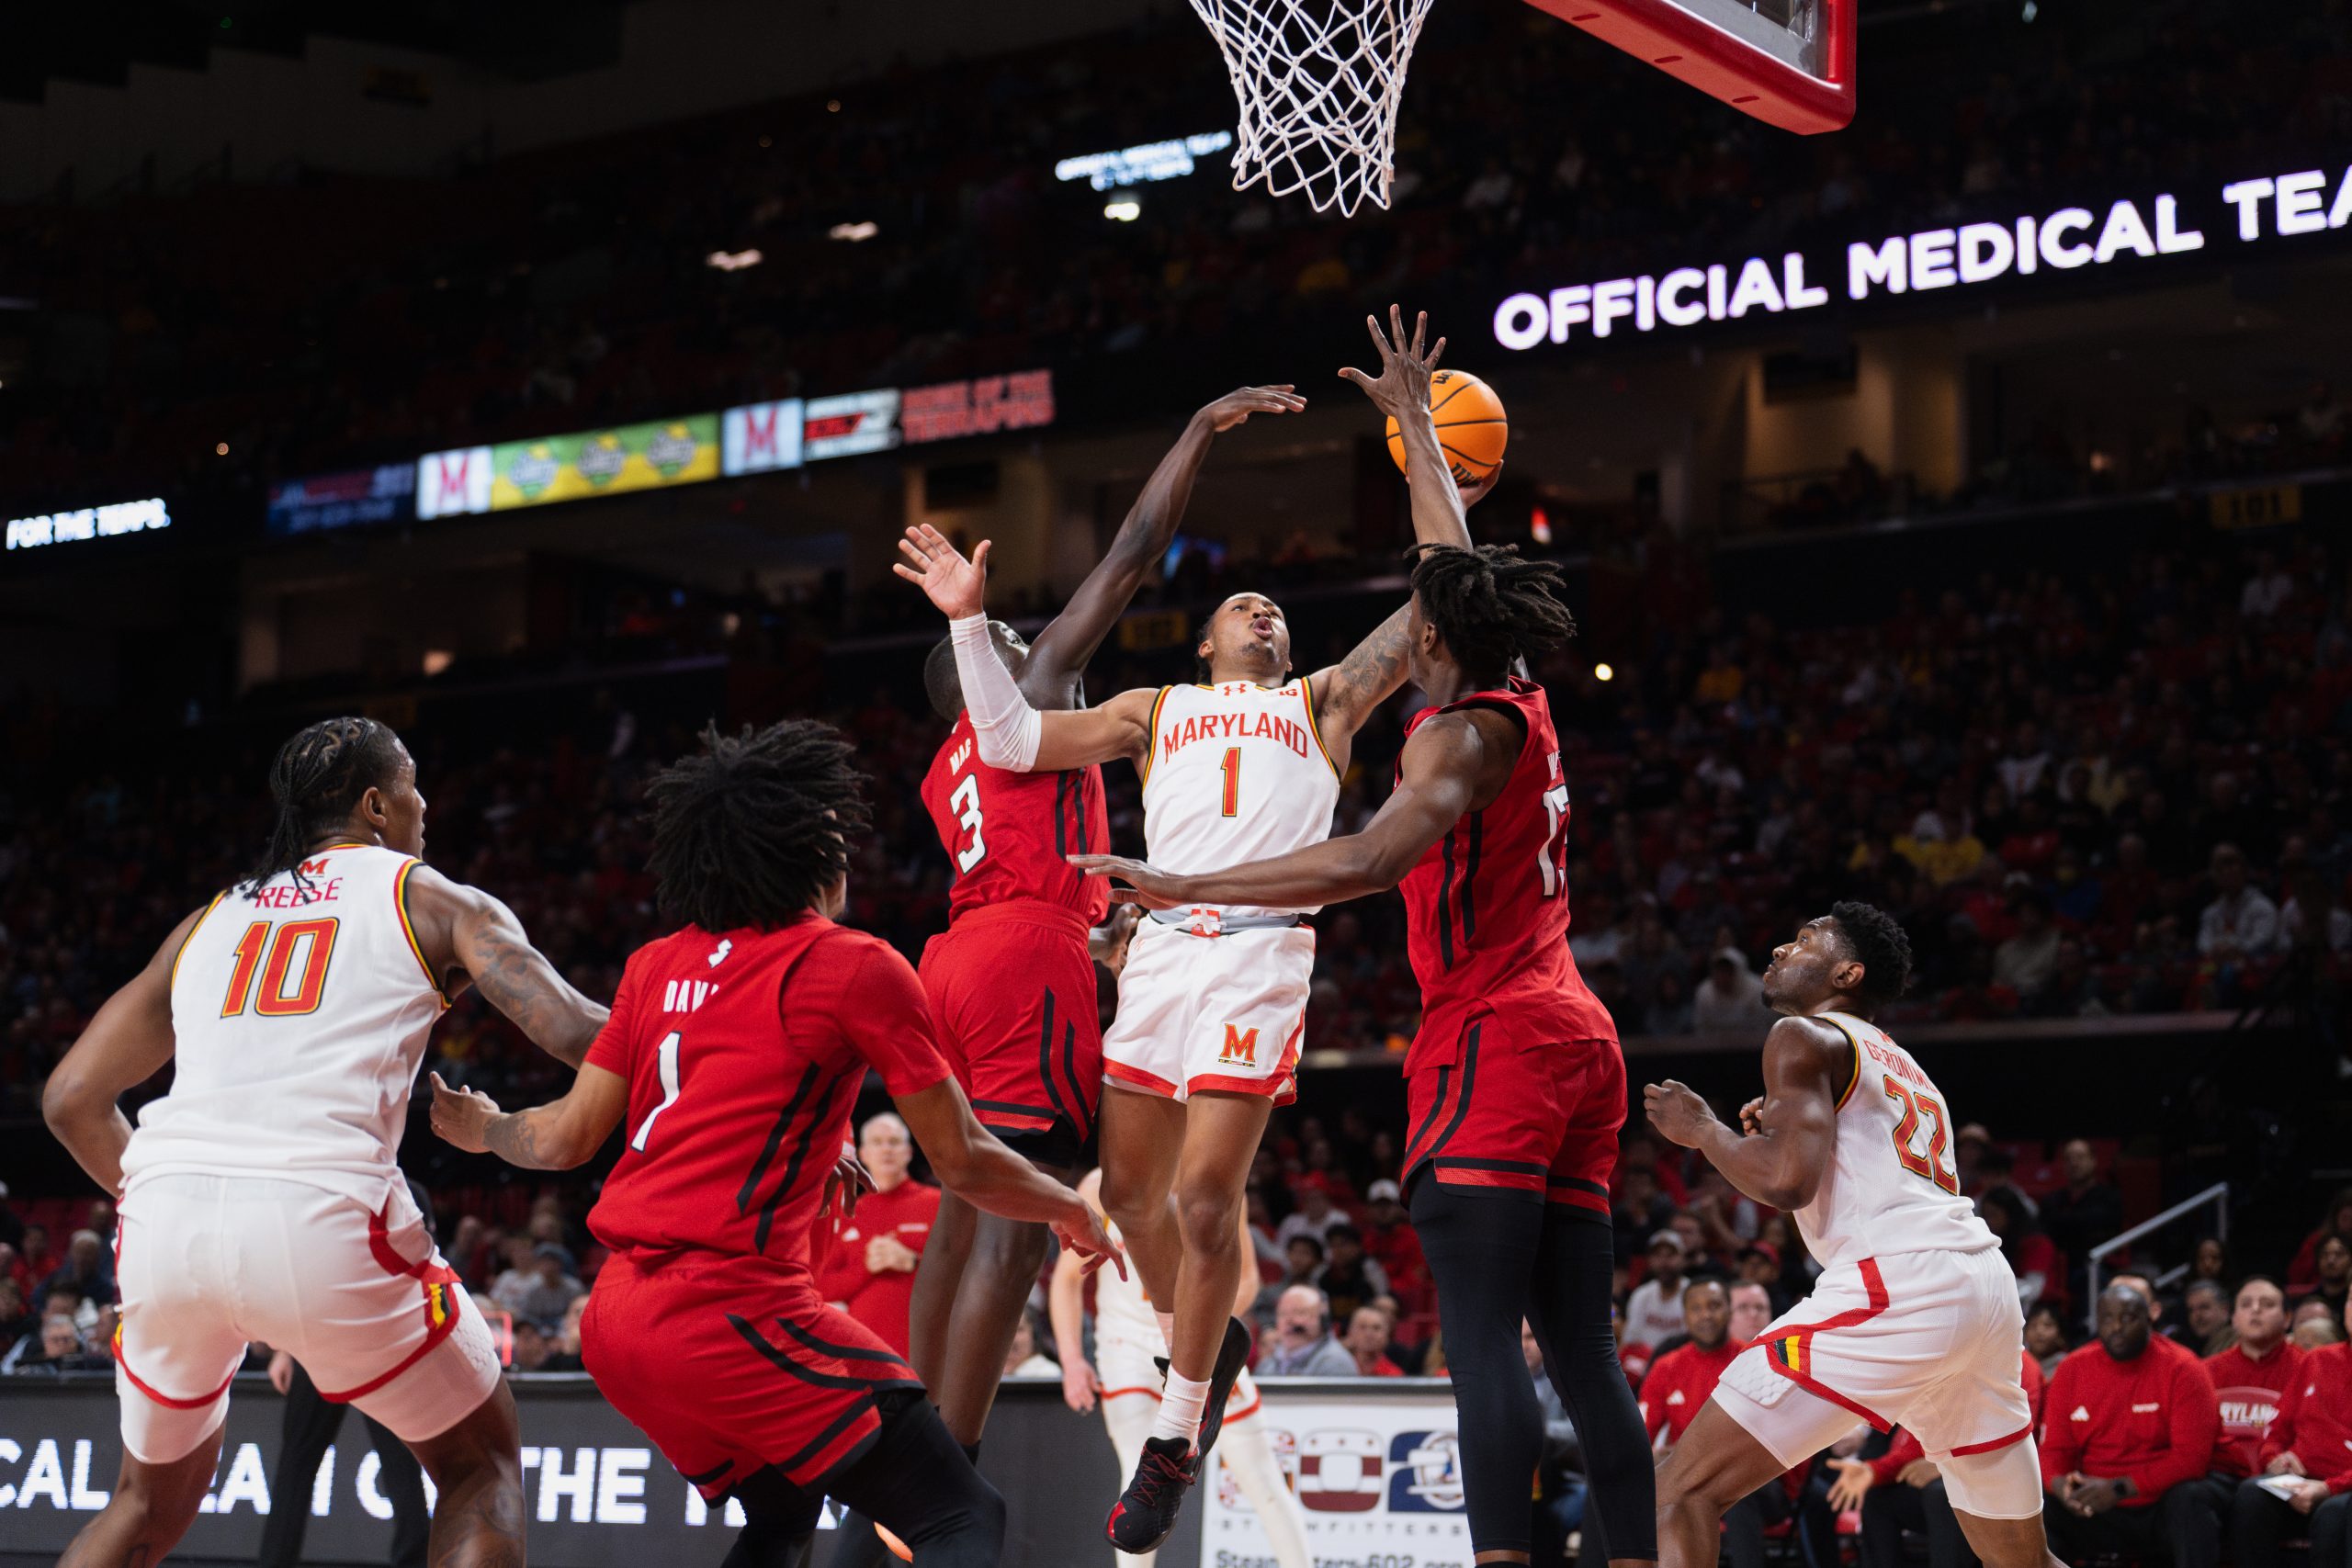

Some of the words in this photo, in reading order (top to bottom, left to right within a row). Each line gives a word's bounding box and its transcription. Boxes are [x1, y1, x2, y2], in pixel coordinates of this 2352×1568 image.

[1494, 253, 1829, 351] OFFICIAL
[1849, 194, 2205, 300] MEDICAL
[949, 738, 971, 776] MAG
[1163, 712, 1308, 765] MARYLAND
[950, 773, 987, 874] 3
[1220, 747, 1241, 818] 1
[254, 877, 344, 908] REESE
[220, 917, 340, 1019] 10
[1218, 1022, 1260, 1063] M
[630, 1031, 682, 1155] 1
[1883, 1074, 1958, 1196] 22
